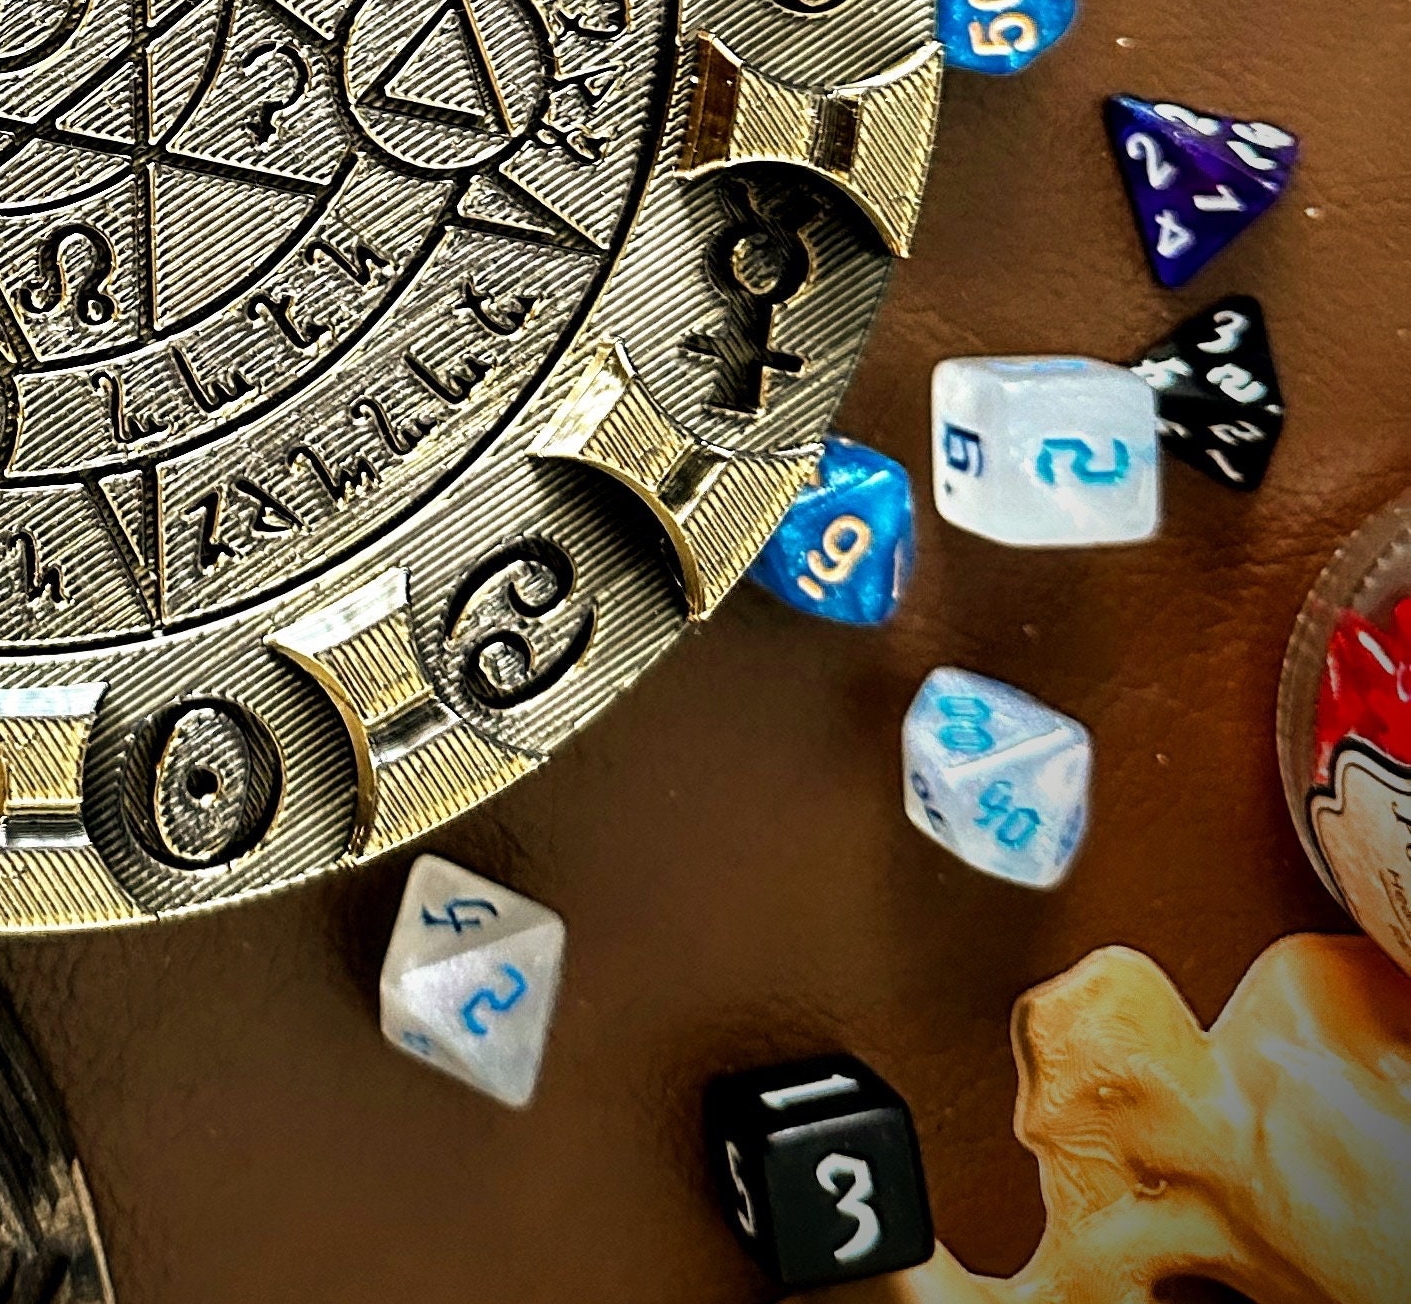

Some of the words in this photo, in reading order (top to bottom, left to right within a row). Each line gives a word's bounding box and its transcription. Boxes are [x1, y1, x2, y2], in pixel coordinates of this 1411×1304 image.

[1125, 132, 1179, 191] 2
[1192, 184, 1247, 213] 1
[1154, 209, 1196, 259] 4
[1196, 309, 1252, 355] 3
[460, 961, 529, 1036] 2
[815, 1151, 883, 1265] 3
